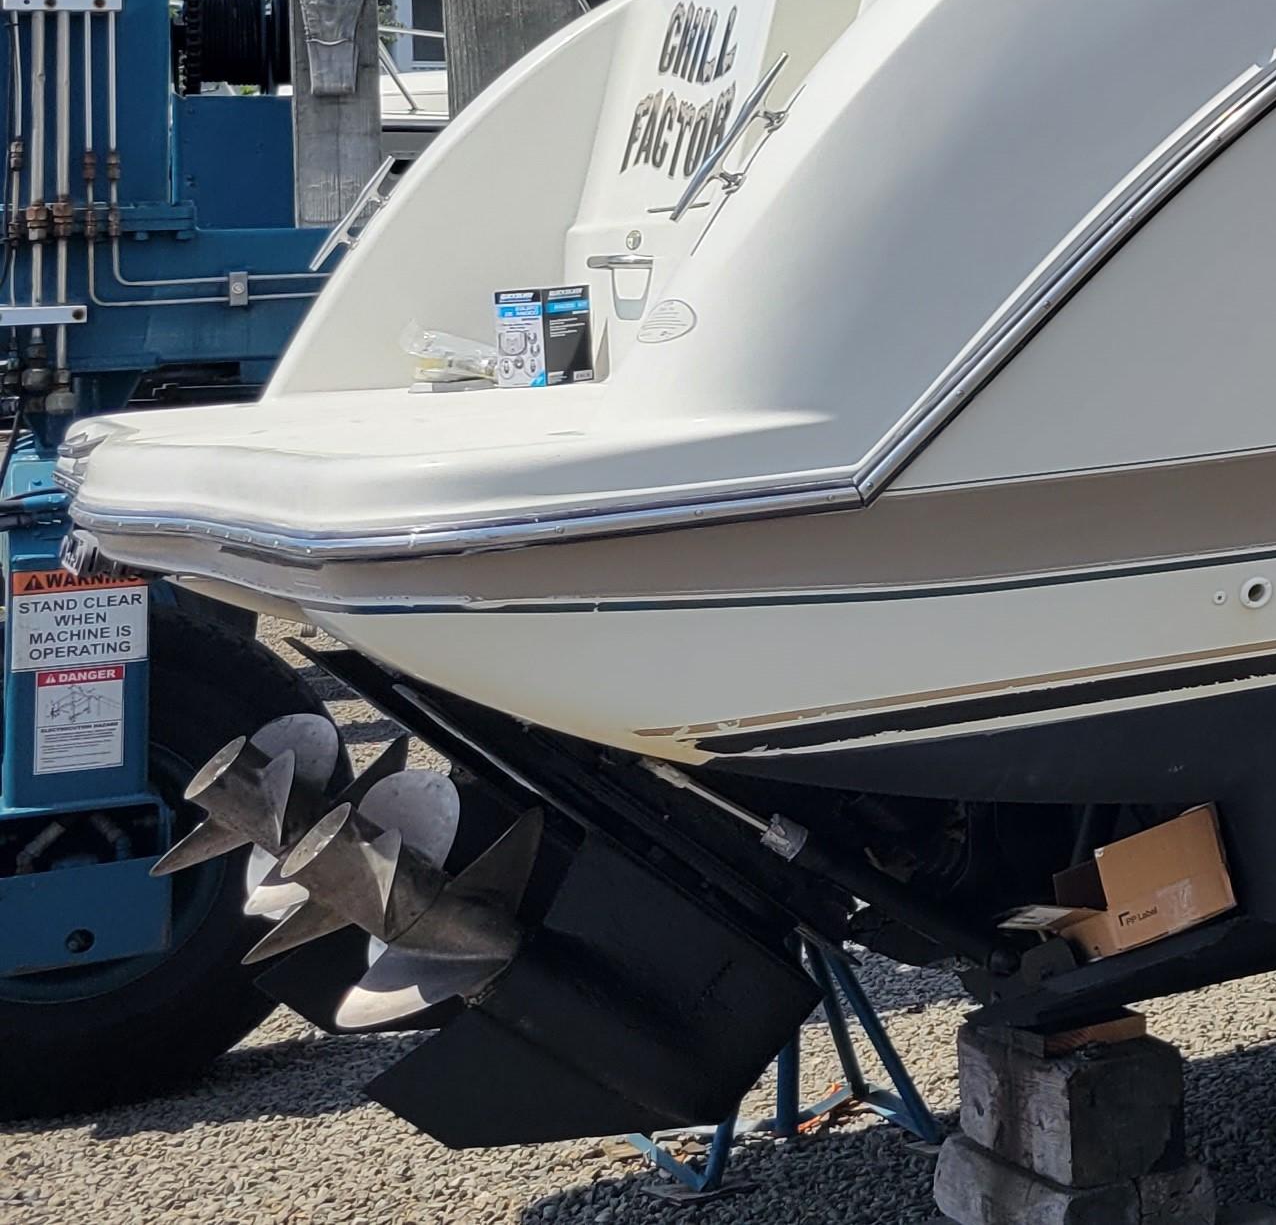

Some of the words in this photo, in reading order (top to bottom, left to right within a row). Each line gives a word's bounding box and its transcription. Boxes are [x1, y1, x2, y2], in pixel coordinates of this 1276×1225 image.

[658, 1, 738, 85] CHILL
[619, 80, 736, 179] FACTOR
[19, 598, 78, 614] STAND
[84, 593, 142, 609] CLEAR
[54, 612, 107, 627] WHEN
[29, 626, 110, 645] MACHINE
[116, 625, 132, 637] IS
[29, 640, 131, 660] OPERATING
[59, 669, 116, 683] DANGER
